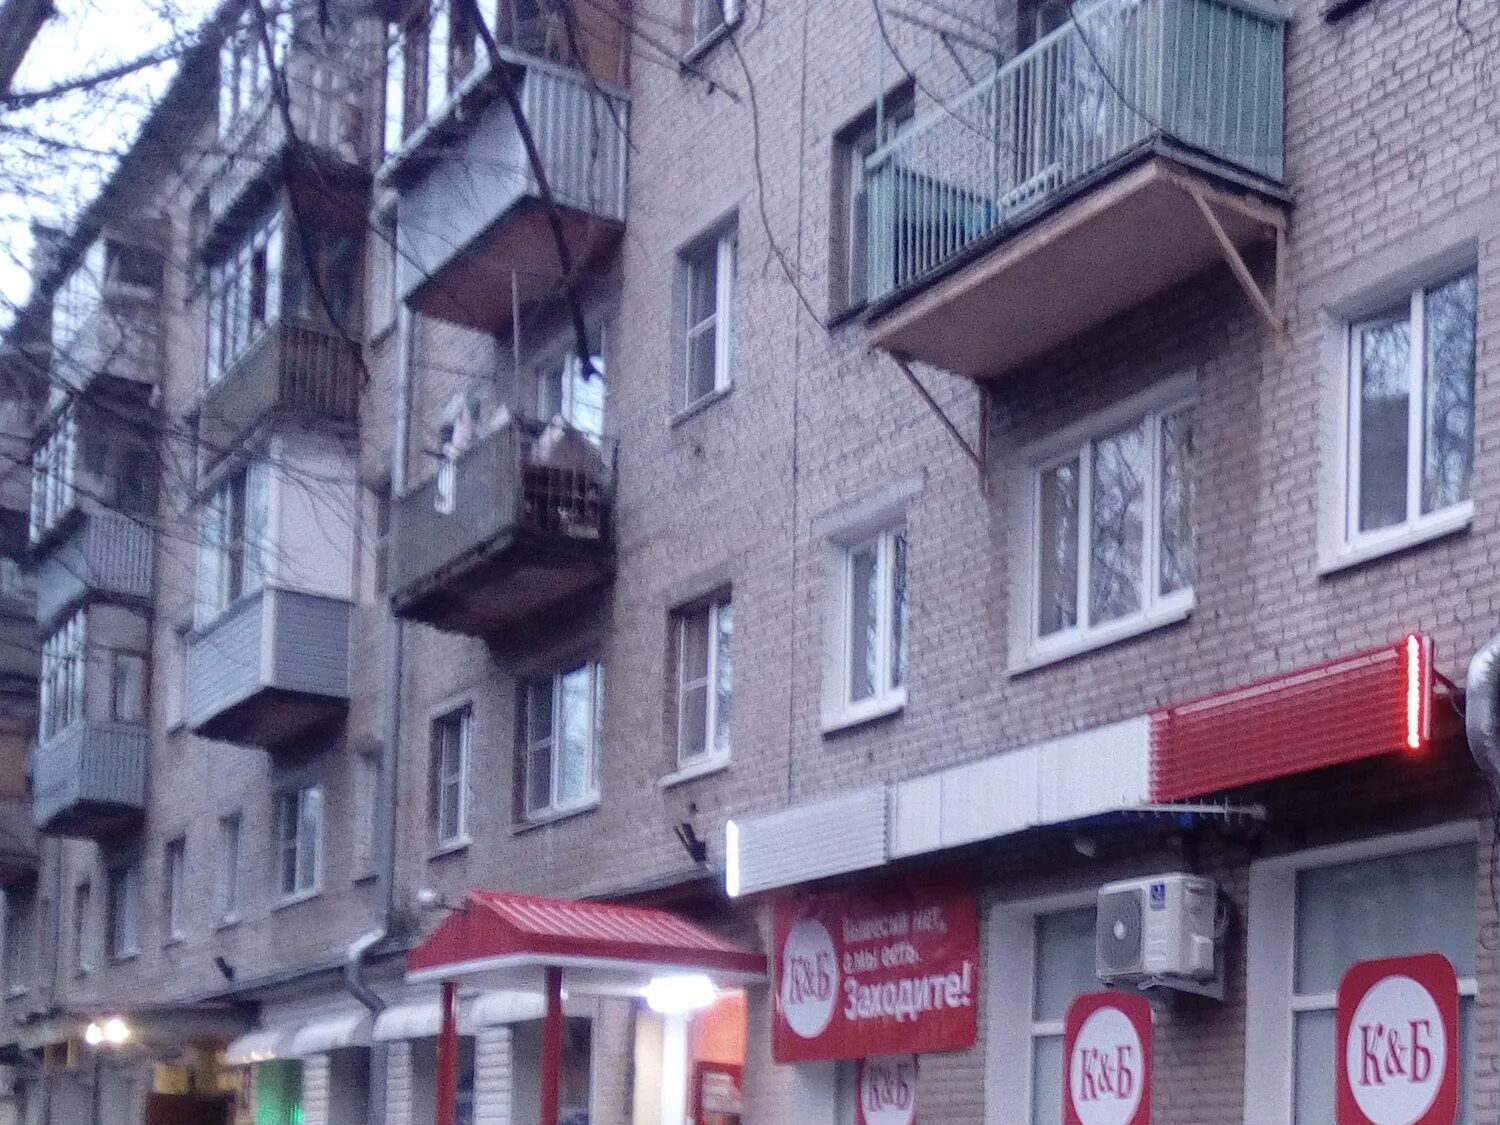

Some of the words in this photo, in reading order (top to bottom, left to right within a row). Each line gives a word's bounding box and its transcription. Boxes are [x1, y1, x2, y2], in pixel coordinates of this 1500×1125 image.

[791, 952, 832, 1004] К&Б
[845, 961, 971, 1021] Заходите!
[1079, 1044, 1133, 1101] К&Б
[1358, 1020, 1432, 1087] К&Б
